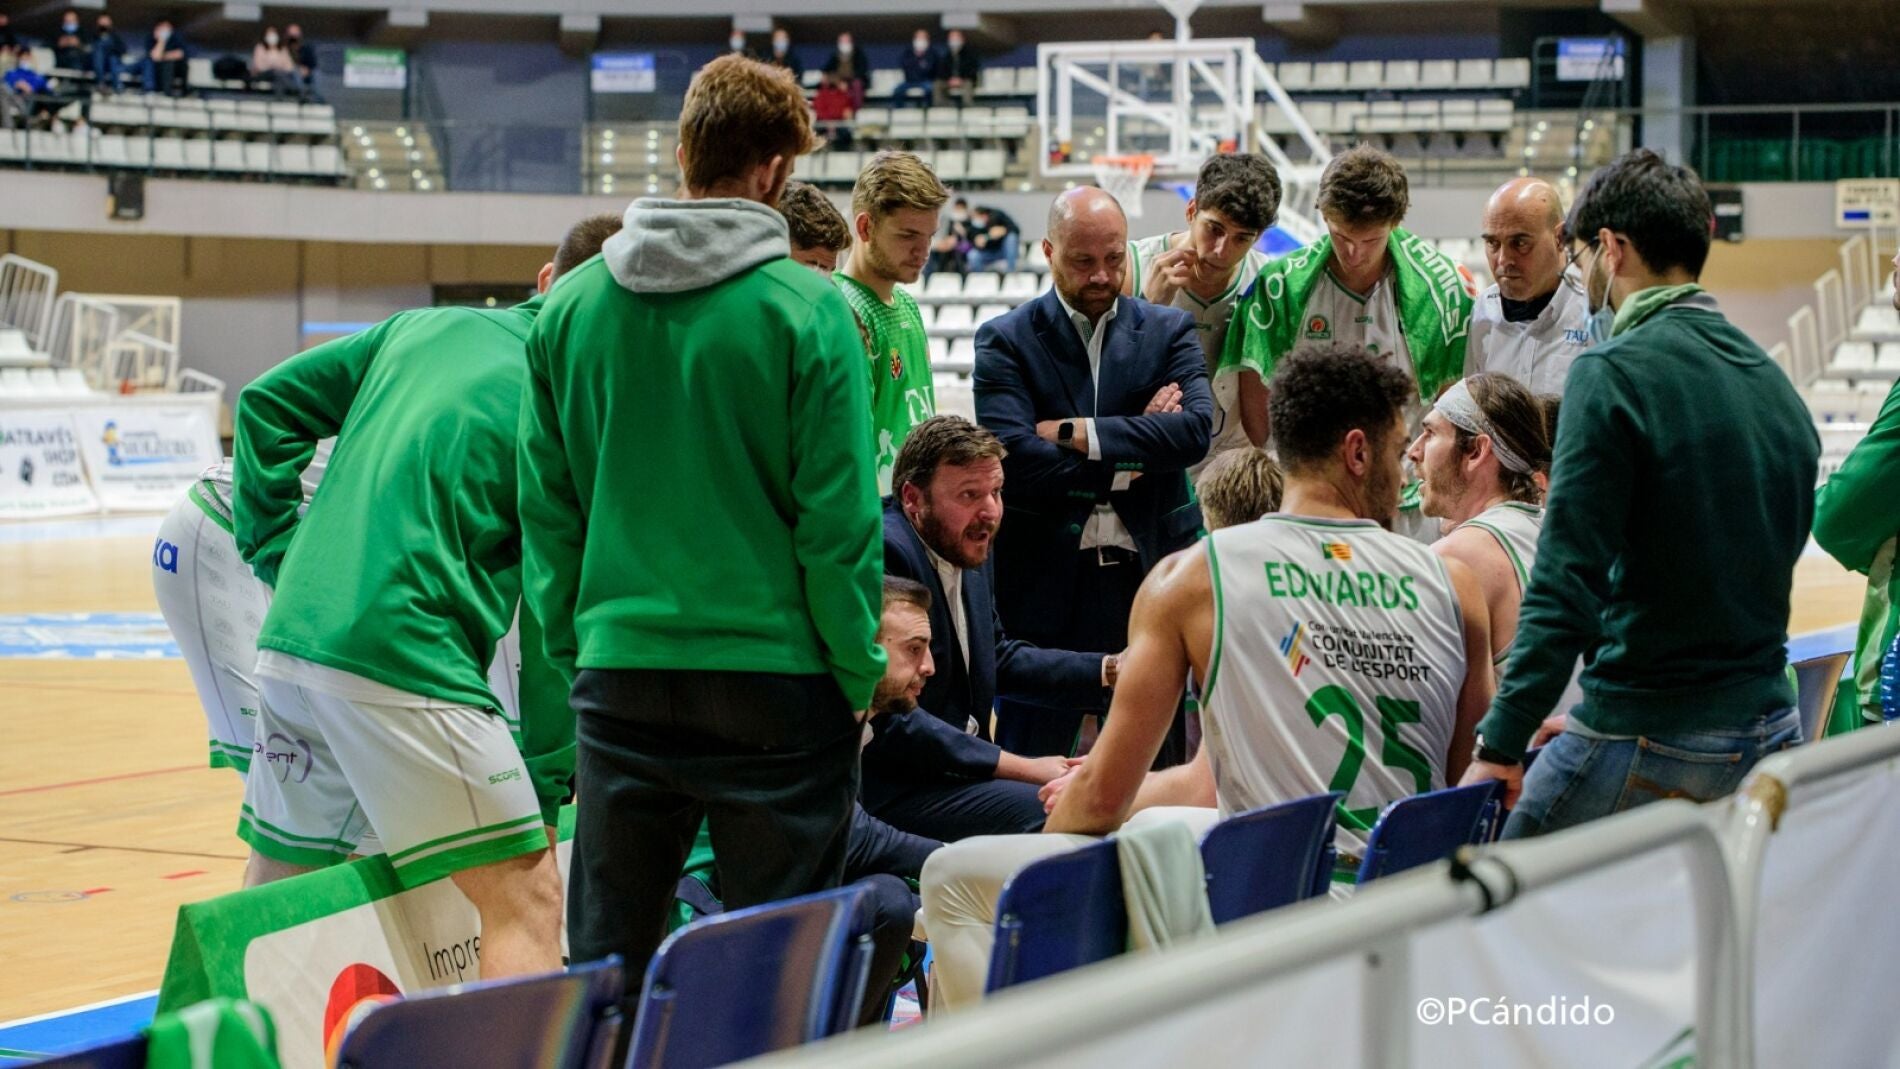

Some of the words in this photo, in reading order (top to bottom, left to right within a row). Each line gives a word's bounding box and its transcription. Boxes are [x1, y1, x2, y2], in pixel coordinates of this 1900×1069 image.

[1265, 561, 1419, 611] EDWARDS
[1324, 653, 1348, 670] DE
[1304, 684, 1431, 831] 25
